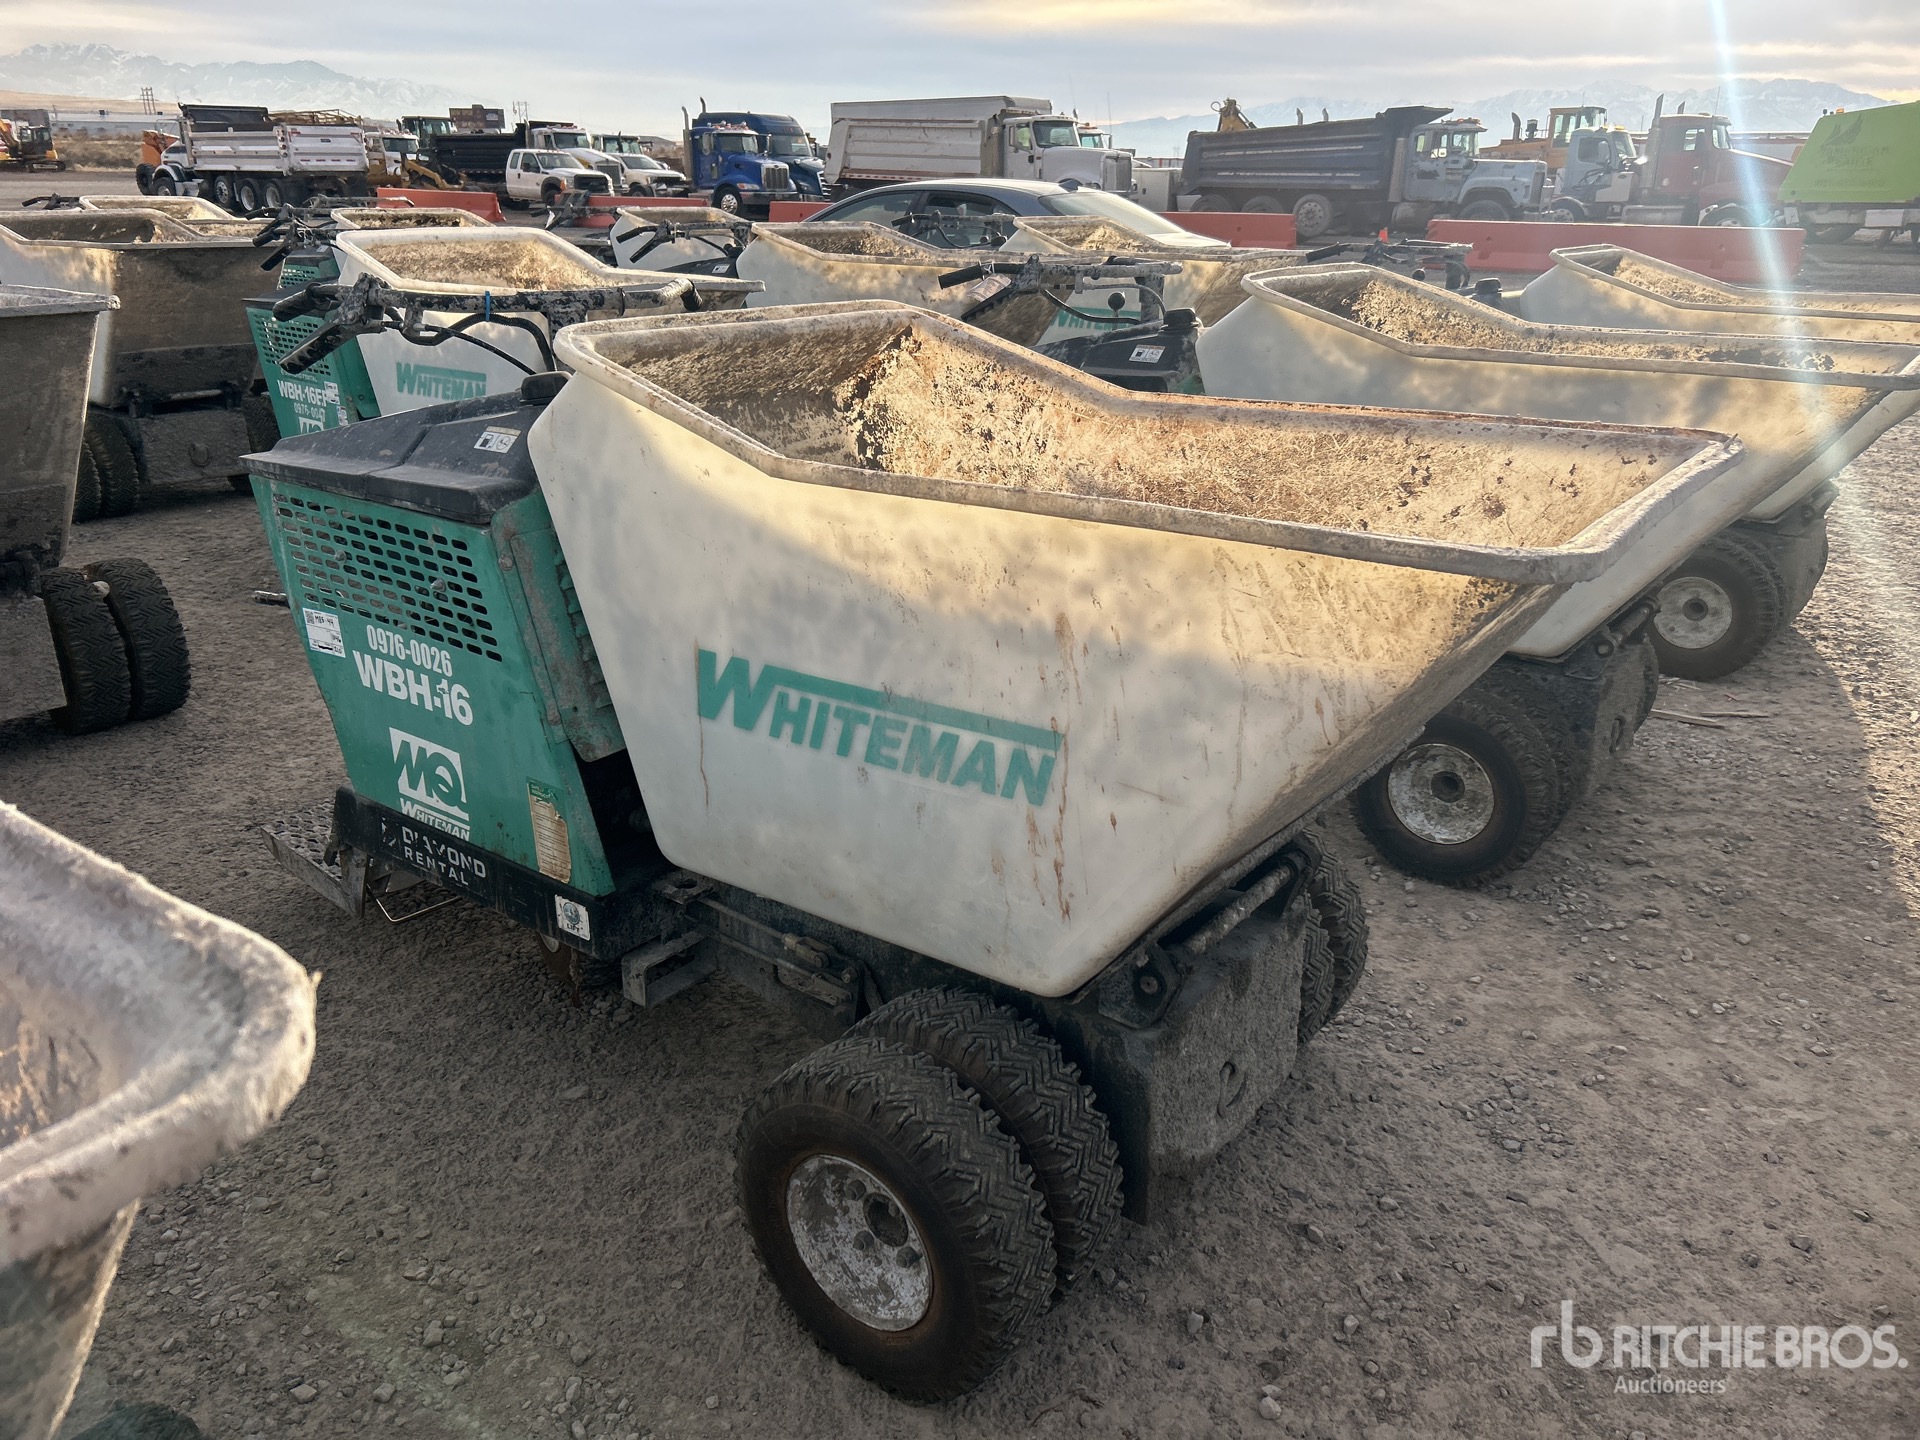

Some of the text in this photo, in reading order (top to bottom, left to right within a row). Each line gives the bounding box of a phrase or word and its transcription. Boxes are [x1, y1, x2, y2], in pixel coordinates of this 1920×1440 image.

[396, 362, 487, 401] WHITEMAN
[366, 624, 453, 677] 0976-0026
[352, 650, 474, 726] WBH-16
[697, 648, 1064, 806] WHITEMAN
[400, 797, 471, 842] WHITEMAN
[404, 846, 469, 886] RENTAL
